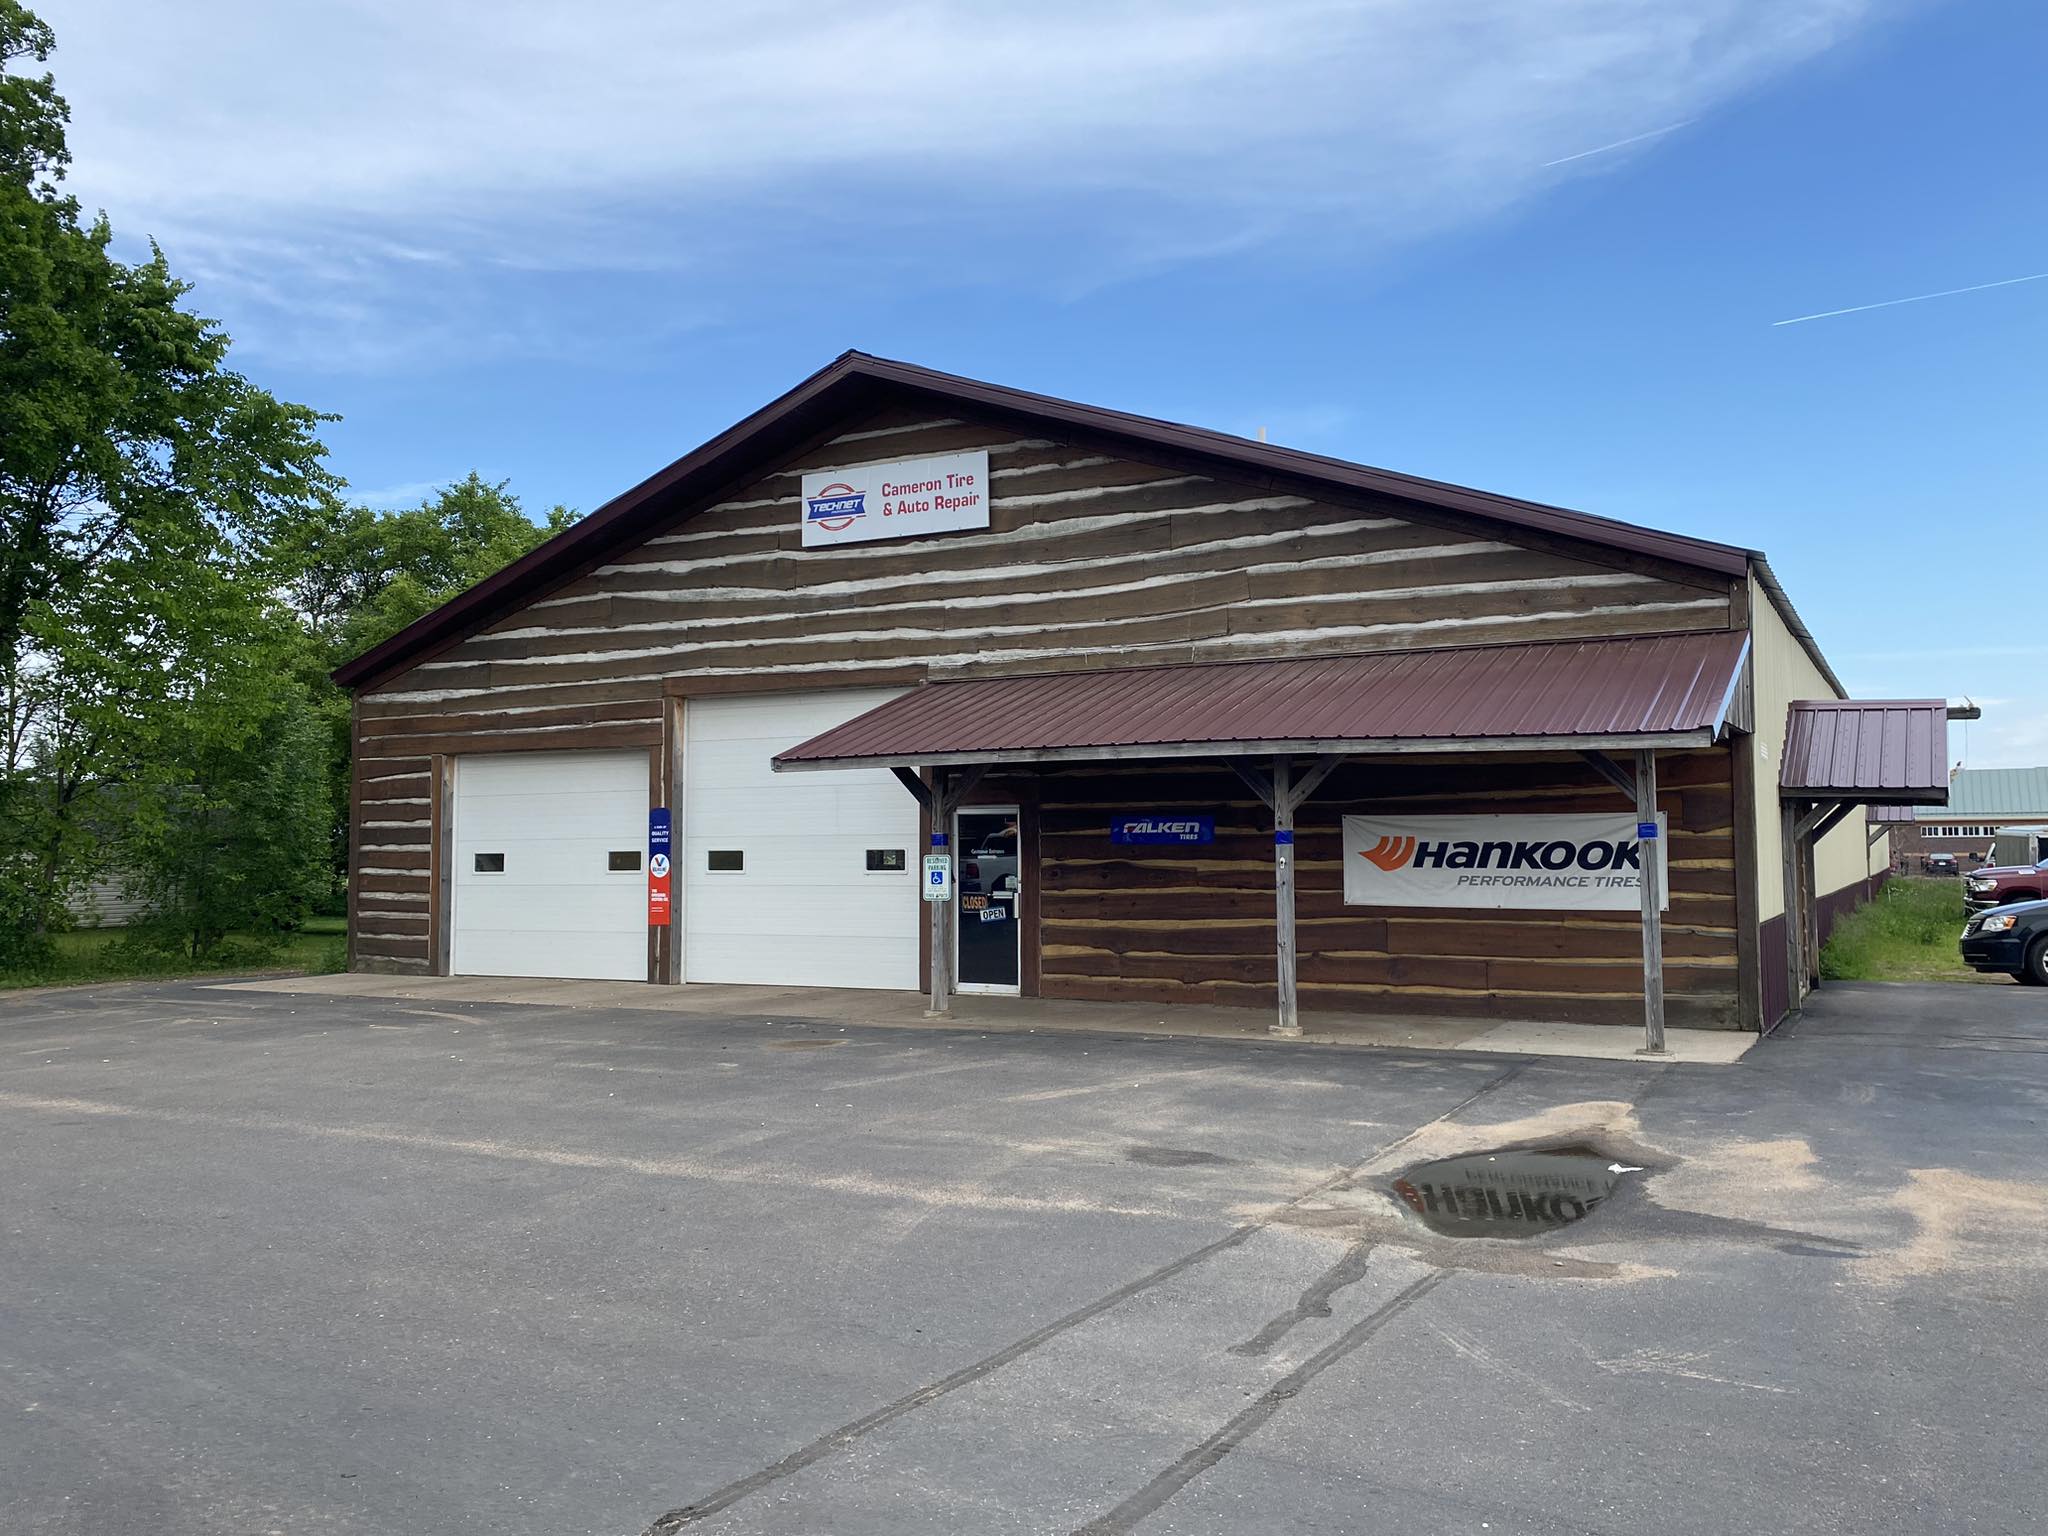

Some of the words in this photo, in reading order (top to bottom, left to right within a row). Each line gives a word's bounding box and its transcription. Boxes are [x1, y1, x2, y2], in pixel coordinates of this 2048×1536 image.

[881, 479, 942, 498] Cameron
[946, 473, 975, 489] Tire
[882, 502, 893, 517] &
[897, 500, 929, 515] Auto
[934, 491, 980, 513] Repair
[1122, 822, 1200, 834] FALKEN
[1179, 833, 1199, 841] TIRES
[1412, 840, 1641, 871] HANKOOK
[1457, 875, 1590, 888] PERFORMANCE
[982, 909, 1004, 920] OPEN
